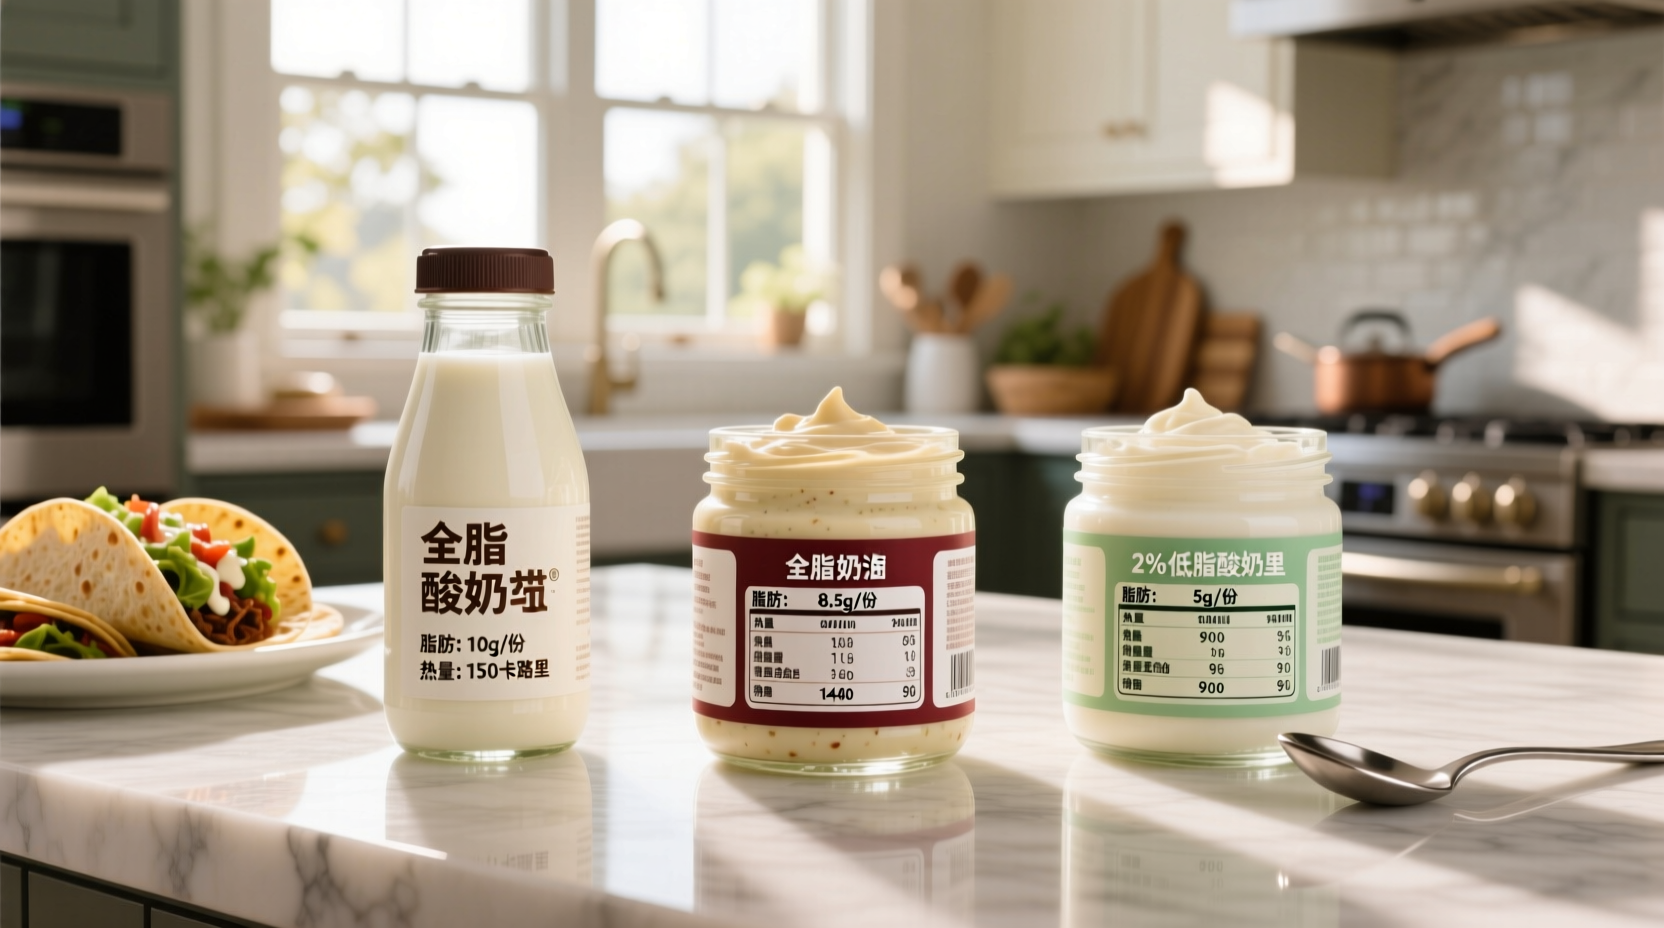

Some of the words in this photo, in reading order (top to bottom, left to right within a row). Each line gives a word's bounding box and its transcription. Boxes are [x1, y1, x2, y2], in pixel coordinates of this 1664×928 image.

[421, 520, 508, 566] 全脂
[1131, 550, 1286, 578] 2%低脂酸奶里
[817, 592, 877, 613] 8.5g/份
[1193, 588, 1238, 608] 5g/份
[420, 633, 461, 654] 脂肪:
[467, 633, 525, 657] 10g/份
[1199, 631, 1225, 643] 900
[466, 659, 550, 680] 150卡路里
[1277, 662, 1291, 674] 90
[902, 685, 916, 698] 90
[1198, 681, 1225, 694] 900
